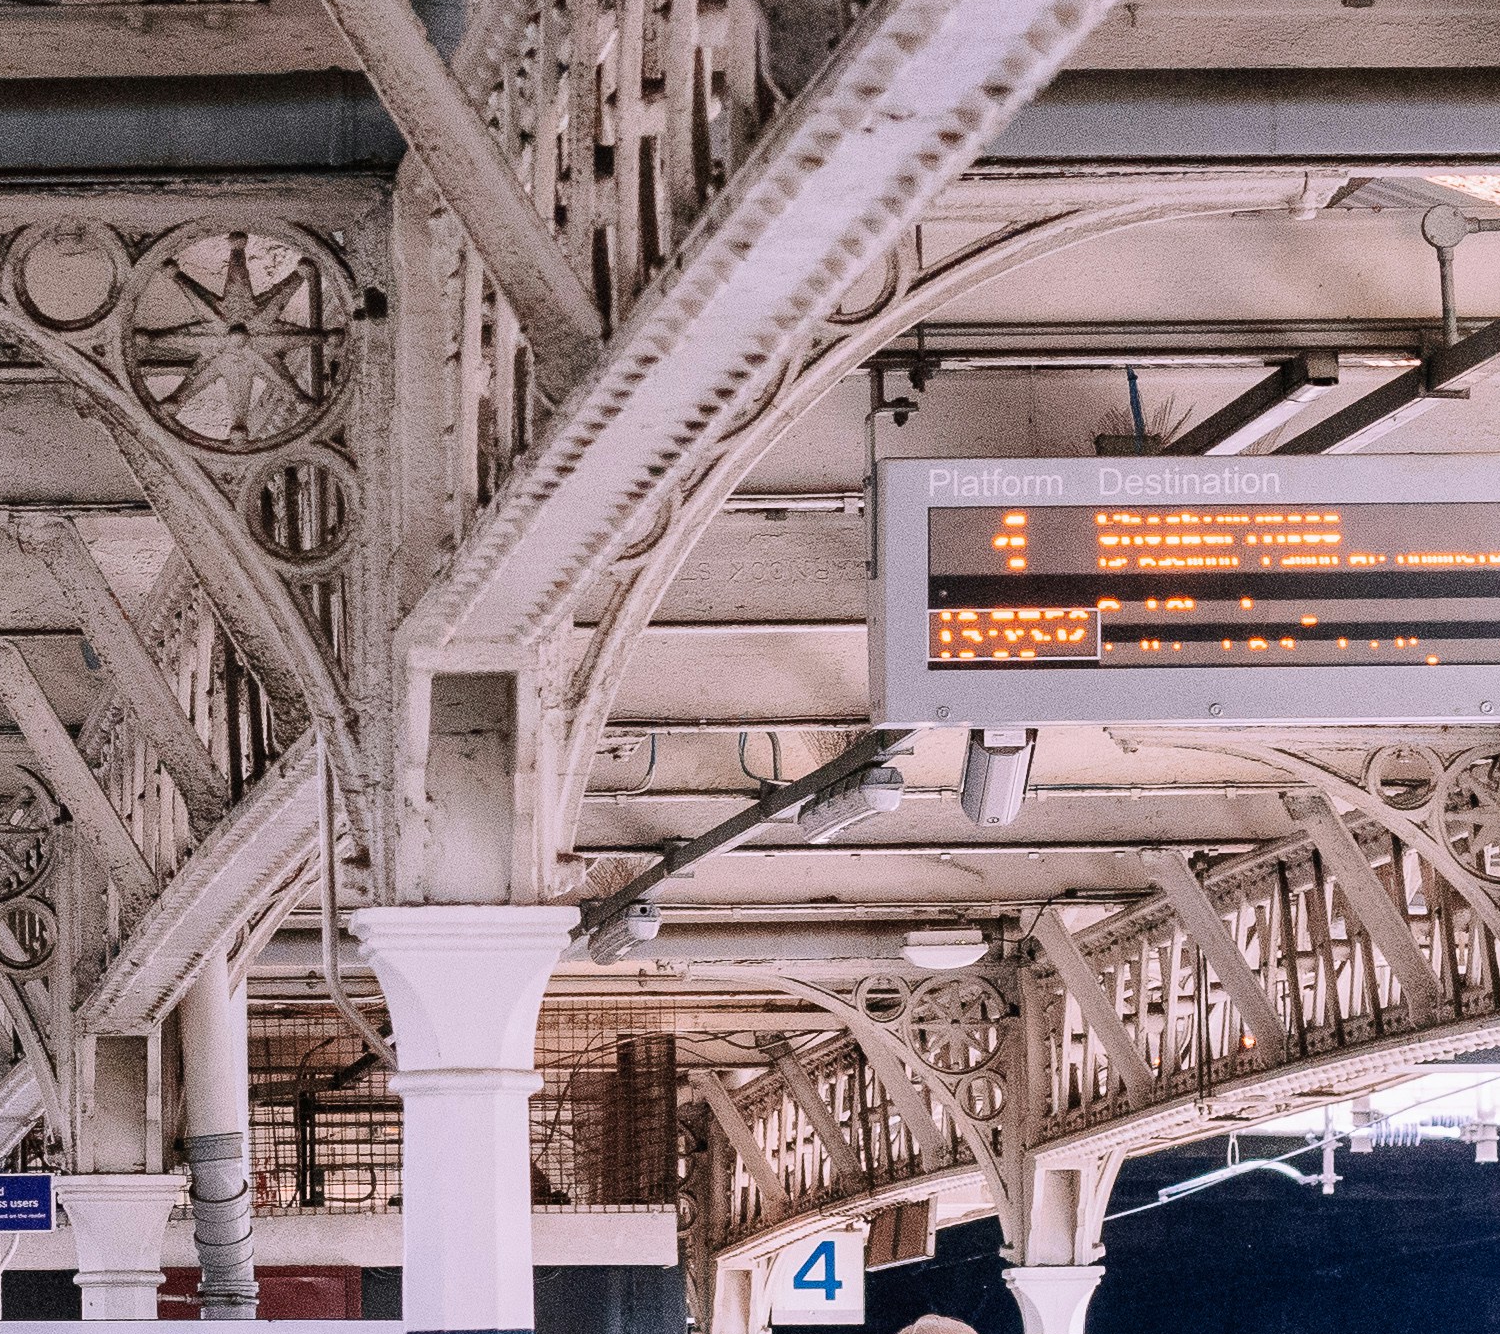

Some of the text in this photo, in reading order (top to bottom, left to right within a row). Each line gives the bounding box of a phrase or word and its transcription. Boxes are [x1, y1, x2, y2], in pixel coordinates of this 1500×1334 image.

[928, 466, 1281, 498] Platform Destination
[10, 1199, 39, 1208] users
[793, 1240, 843, 1302] 4
